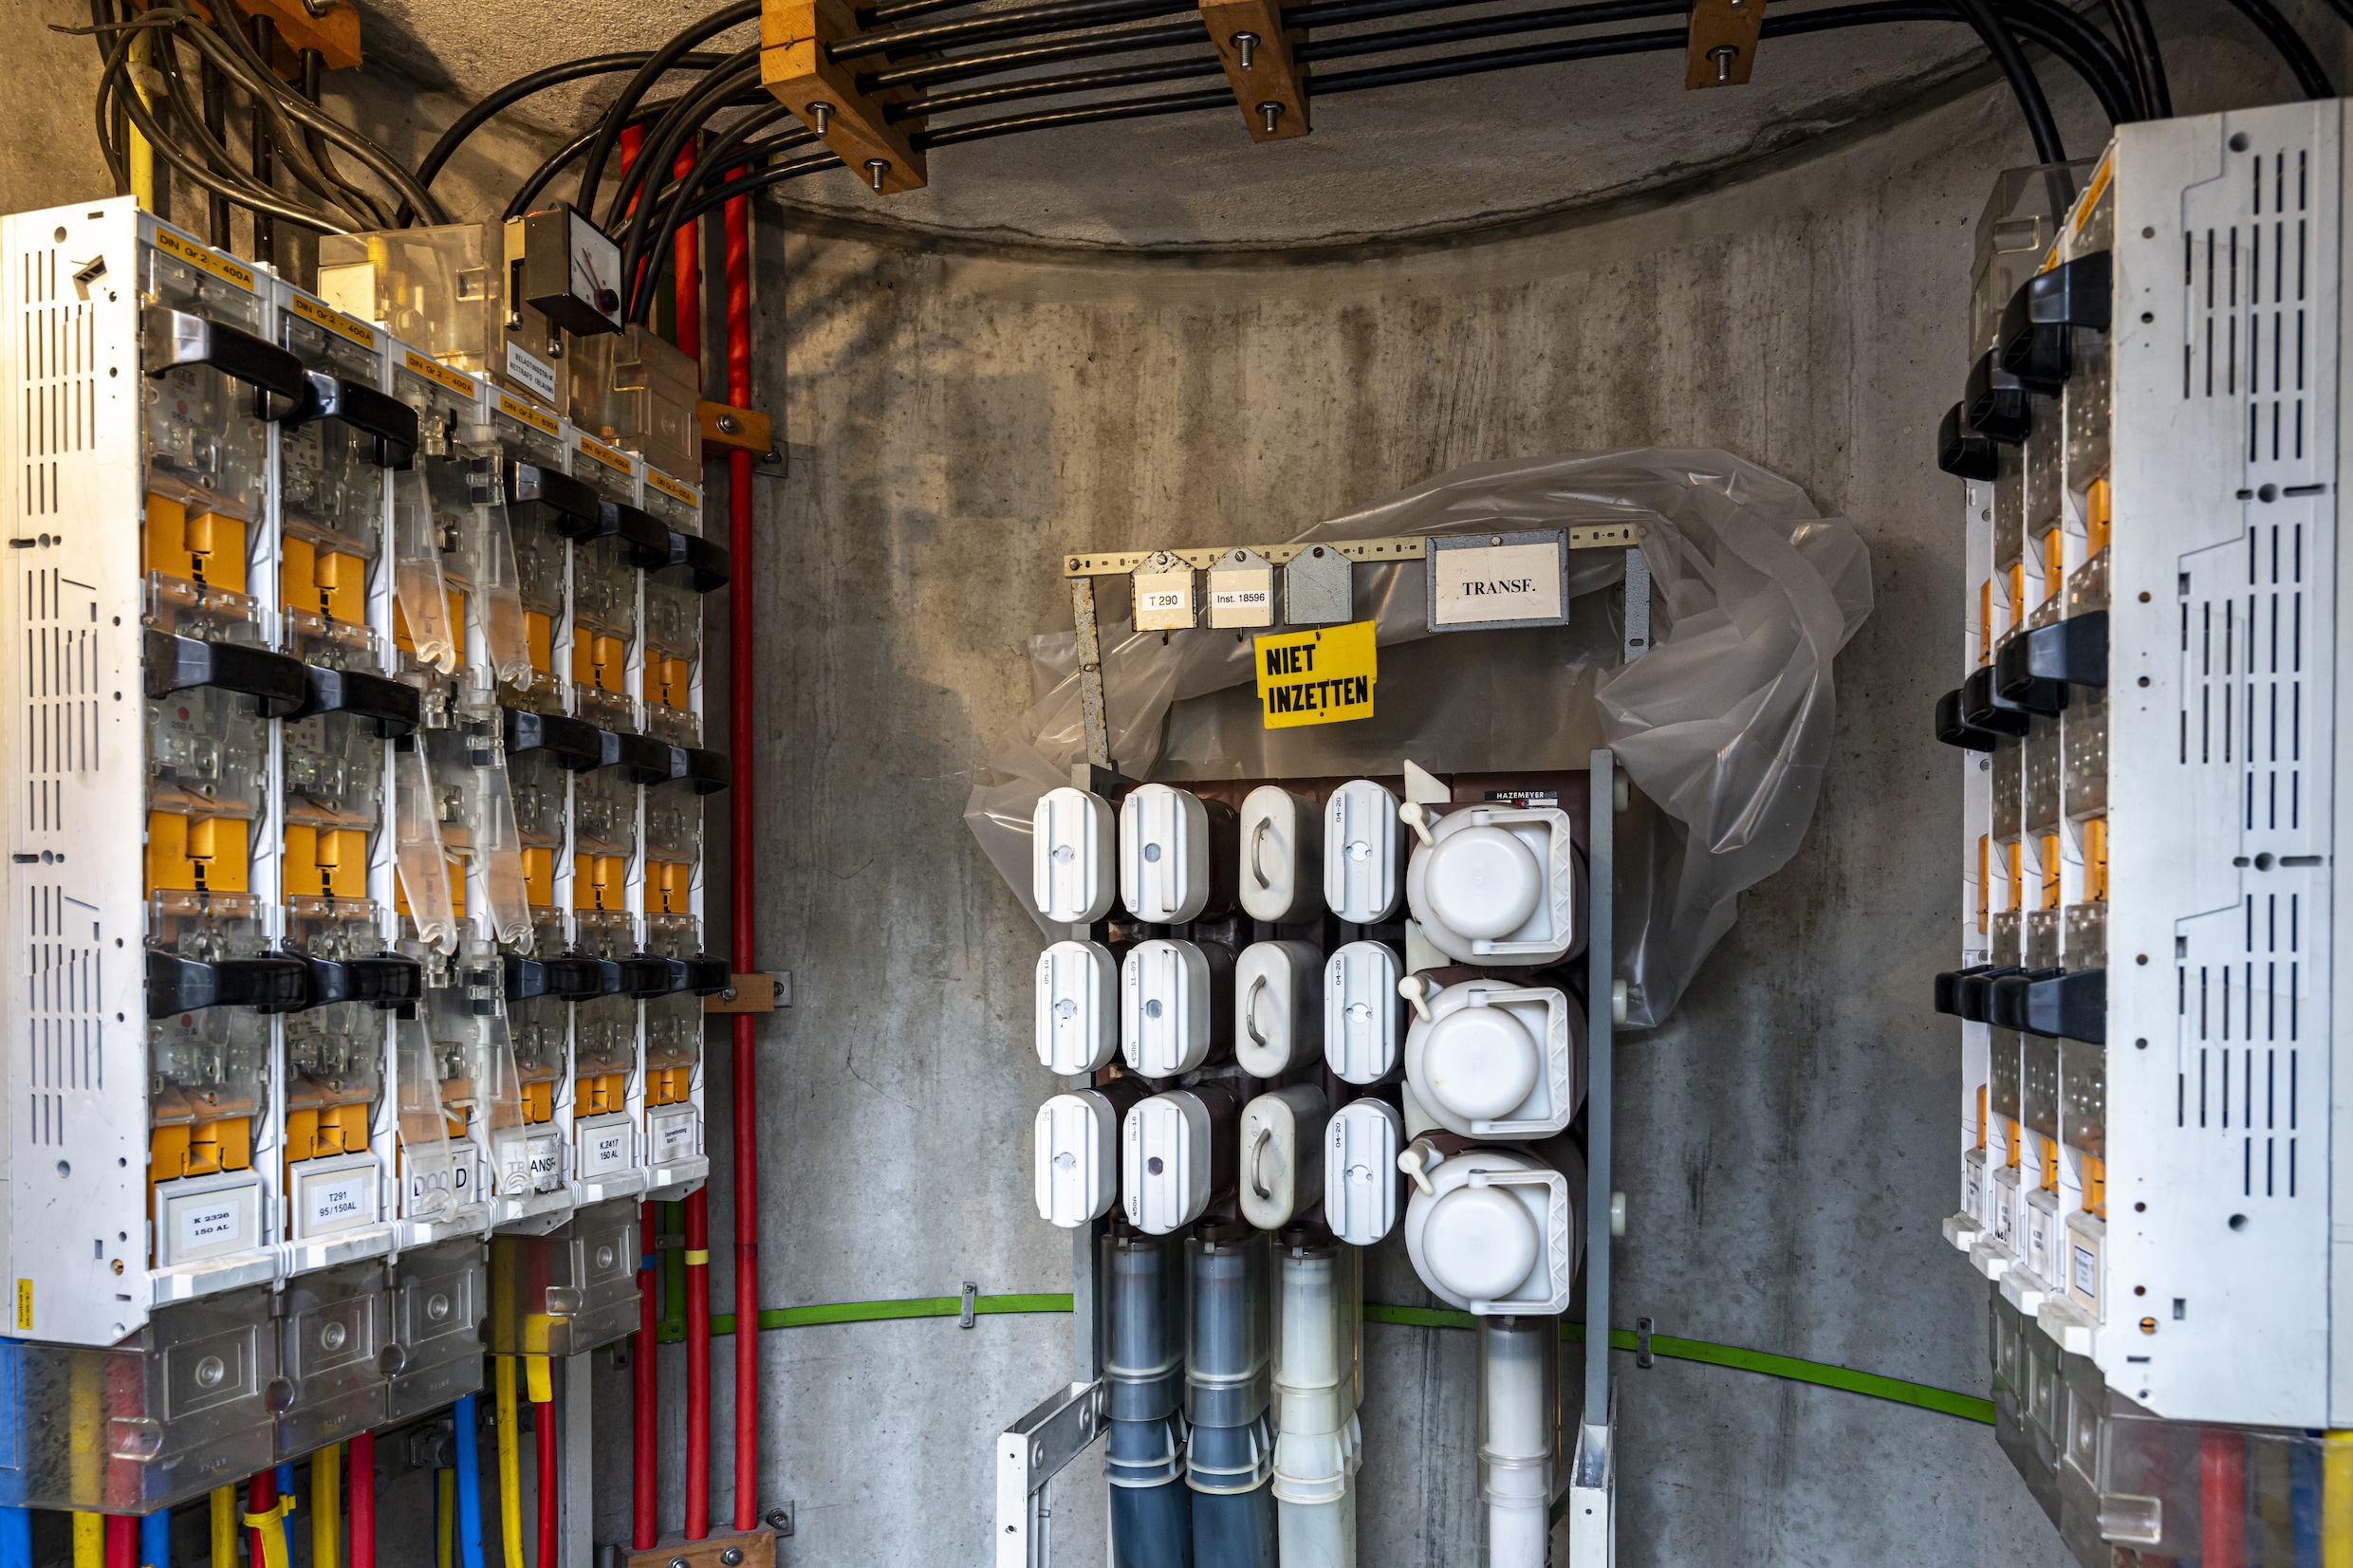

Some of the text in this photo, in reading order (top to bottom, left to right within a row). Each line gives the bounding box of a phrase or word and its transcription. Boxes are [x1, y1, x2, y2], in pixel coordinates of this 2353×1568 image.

[159, 234, 179, 250] DIN
[185, 247, 207, 264] Gr.2
[222, 265, 250, 284] 400A
[296, 300, 312, 314] DIN
[317, 308, 335, 324] Gr.2
[348, 324, 371, 341] 400A
[409, 358, 423, 369] DIN
[427, 365, 442, 378] Gr.2
[453, 378, 472, 393] 400A
[504, 400, 516, 412] DIN
[542, 419, 558, 432] 630A
[582, 441, 592, 452] DIN
[614, 458, 628, 469] 400A
[1462, 579, 1536, 596] TRANSF.
[1149, 595, 1177, 606] T 290
[1217, 593, 1265, 603] Inst. 18596
[1266, 643, 1316, 675] NIET
[1269, 675, 1368, 713] INZETTEN
[171, 721, 186, 729] 250
[1496, 791, 1545, 800] HAZEMEYER
[600, 1138, 619, 1150] K.2417
[600, 1150, 619, 1160] 150 AL
[329, 1191, 346, 1202] T291
[319, 1202, 357, 1216] 95/150AL
[204, 1212, 230, 1222] 2326
[195, 1227, 213, 1236] 150
